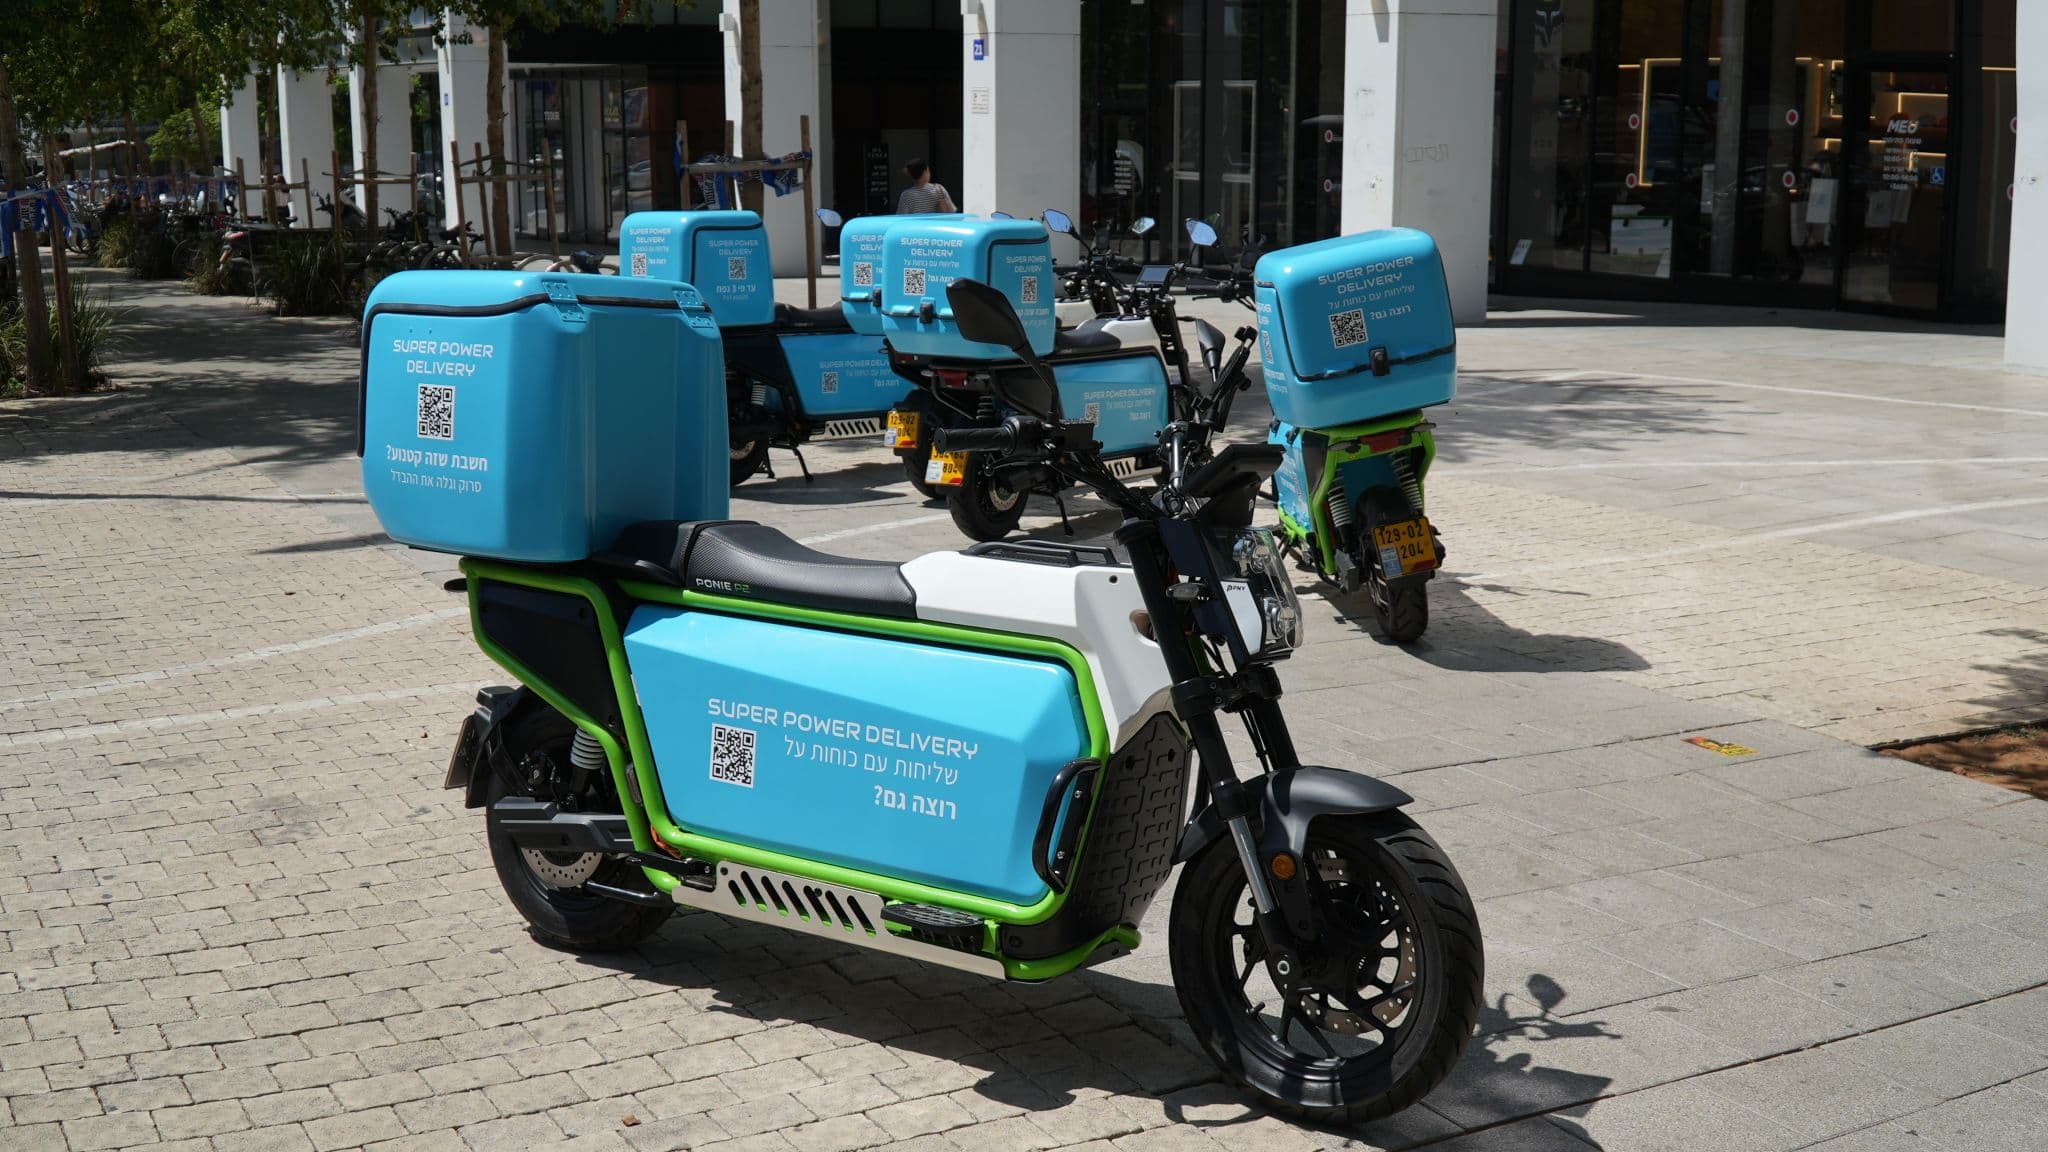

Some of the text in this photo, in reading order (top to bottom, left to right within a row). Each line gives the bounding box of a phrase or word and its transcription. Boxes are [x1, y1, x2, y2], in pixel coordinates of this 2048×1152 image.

[629, 227, 650, 235] SUPER
[900, 237, 963, 248] SUPER POWER
[719, 248, 753, 256] DELIVERY
[911, 248, 953, 257] DELIVERY
[1006, 255, 1047, 264] SUPER POWER
[1318, 256, 1414, 285] SUPER POWER
[1337, 272, 1402, 294] DELIVERY
[1369, 291, 1384, 301] עם
[1384, 285, 1415, 298] שליחות
[1328, 298, 1343, 310] על
[1370, 305, 1411, 321] רוצה גם?
[393, 340, 494, 358] SUPER POWER
[407, 360, 475, 376] DELIVERY
[1084, 387, 1156, 400] SUPER POWER DELIVERY
[386, 444, 488, 471] חשבת שזה קטנוע?
[391, 468, 482, 494] פרוק וגלה את ההבדל
[1400, 541, 1424, 559] 204
[696, 578, 751, 593] PONIE P2
[708, 698, 978, 760] SUPER POWER DELIVERY
[784, 734, 958, 785] שליחות עם כוחות על
[874, 785, 957, 820] רוצה גם?
